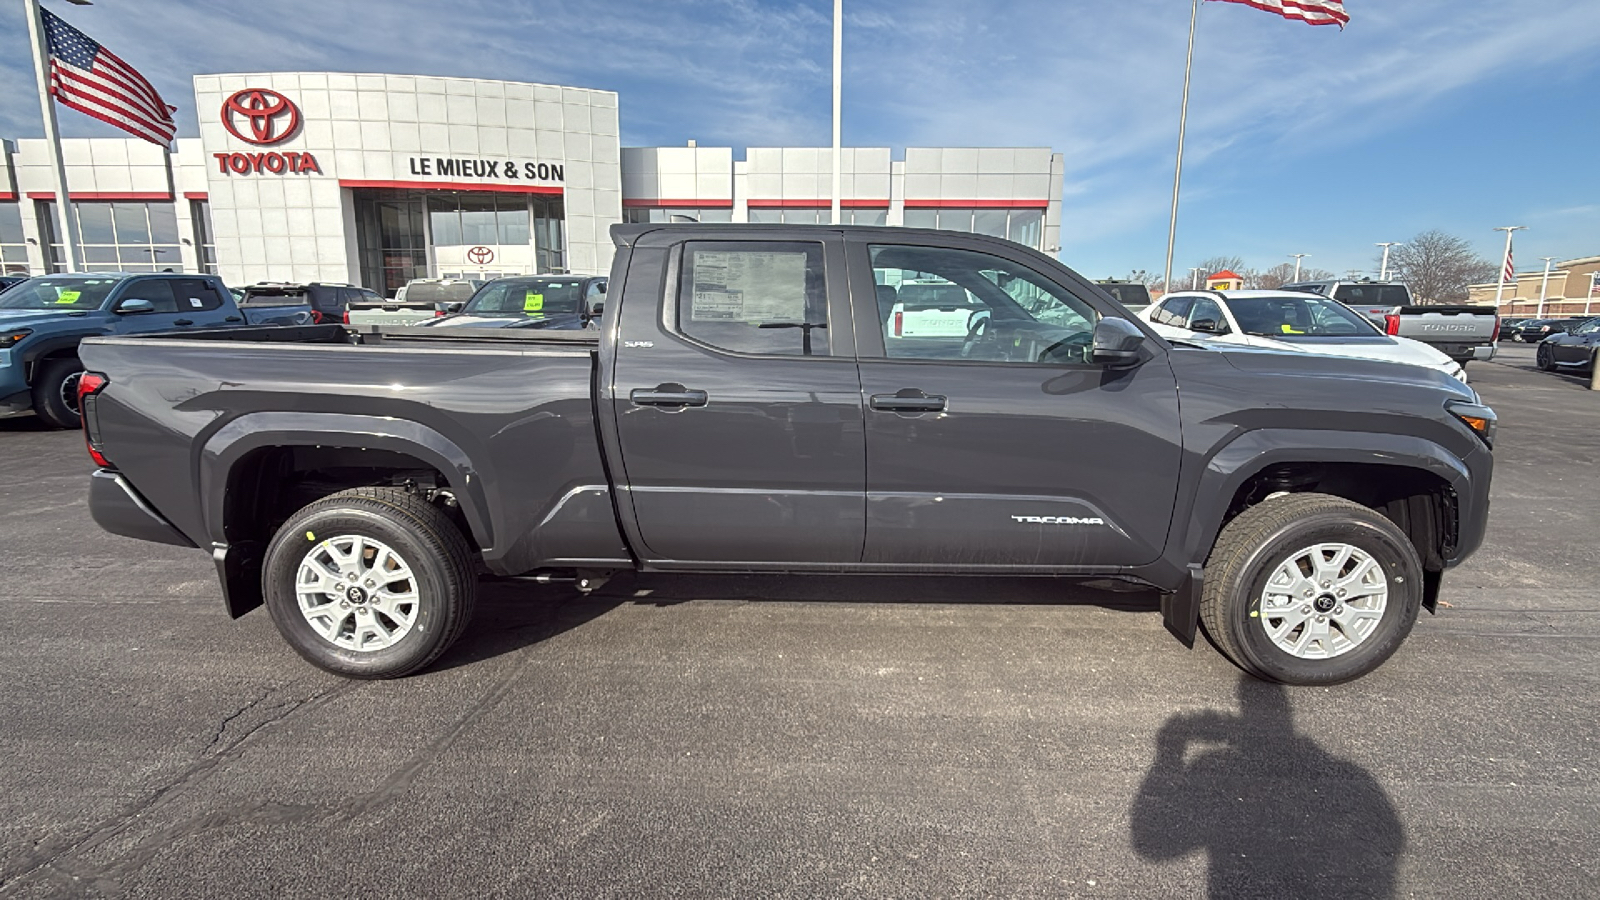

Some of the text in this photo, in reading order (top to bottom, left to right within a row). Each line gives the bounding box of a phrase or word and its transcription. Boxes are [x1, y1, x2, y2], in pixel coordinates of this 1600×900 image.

[213, 151, 319, 174] TOYOTA
[409, 157, 565, 181] LE MIEUX & SON
[1421, 323, 1477, 332] TUNDRA
[1011, 514, 1104, 525] TACOMA
